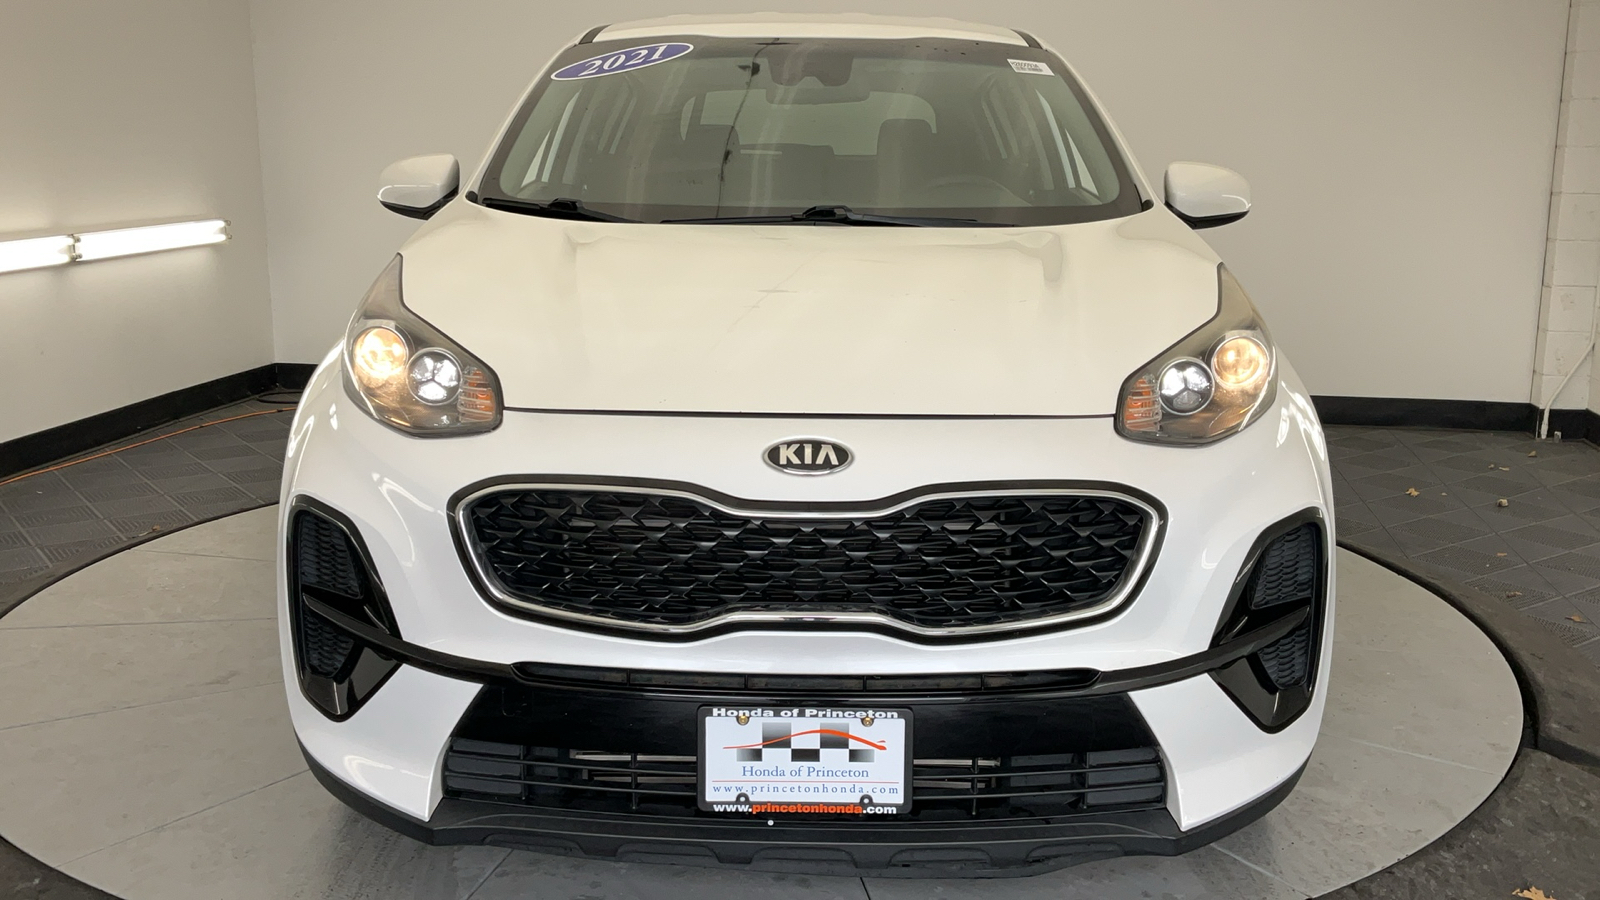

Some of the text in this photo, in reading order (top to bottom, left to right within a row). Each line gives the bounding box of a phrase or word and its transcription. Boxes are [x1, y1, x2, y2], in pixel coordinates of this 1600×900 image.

[578, 45, 668, 76] 2021
[779, 444, 839, 465] KIA
[713, 708, 898, 719] Honda of Princeton
[742, 766, 869, 778] Honda of Princeton
[713, 784, 898, 794] www.princetonhonda.com
[713, 802, 897, 814] www.princetonhonda.com
